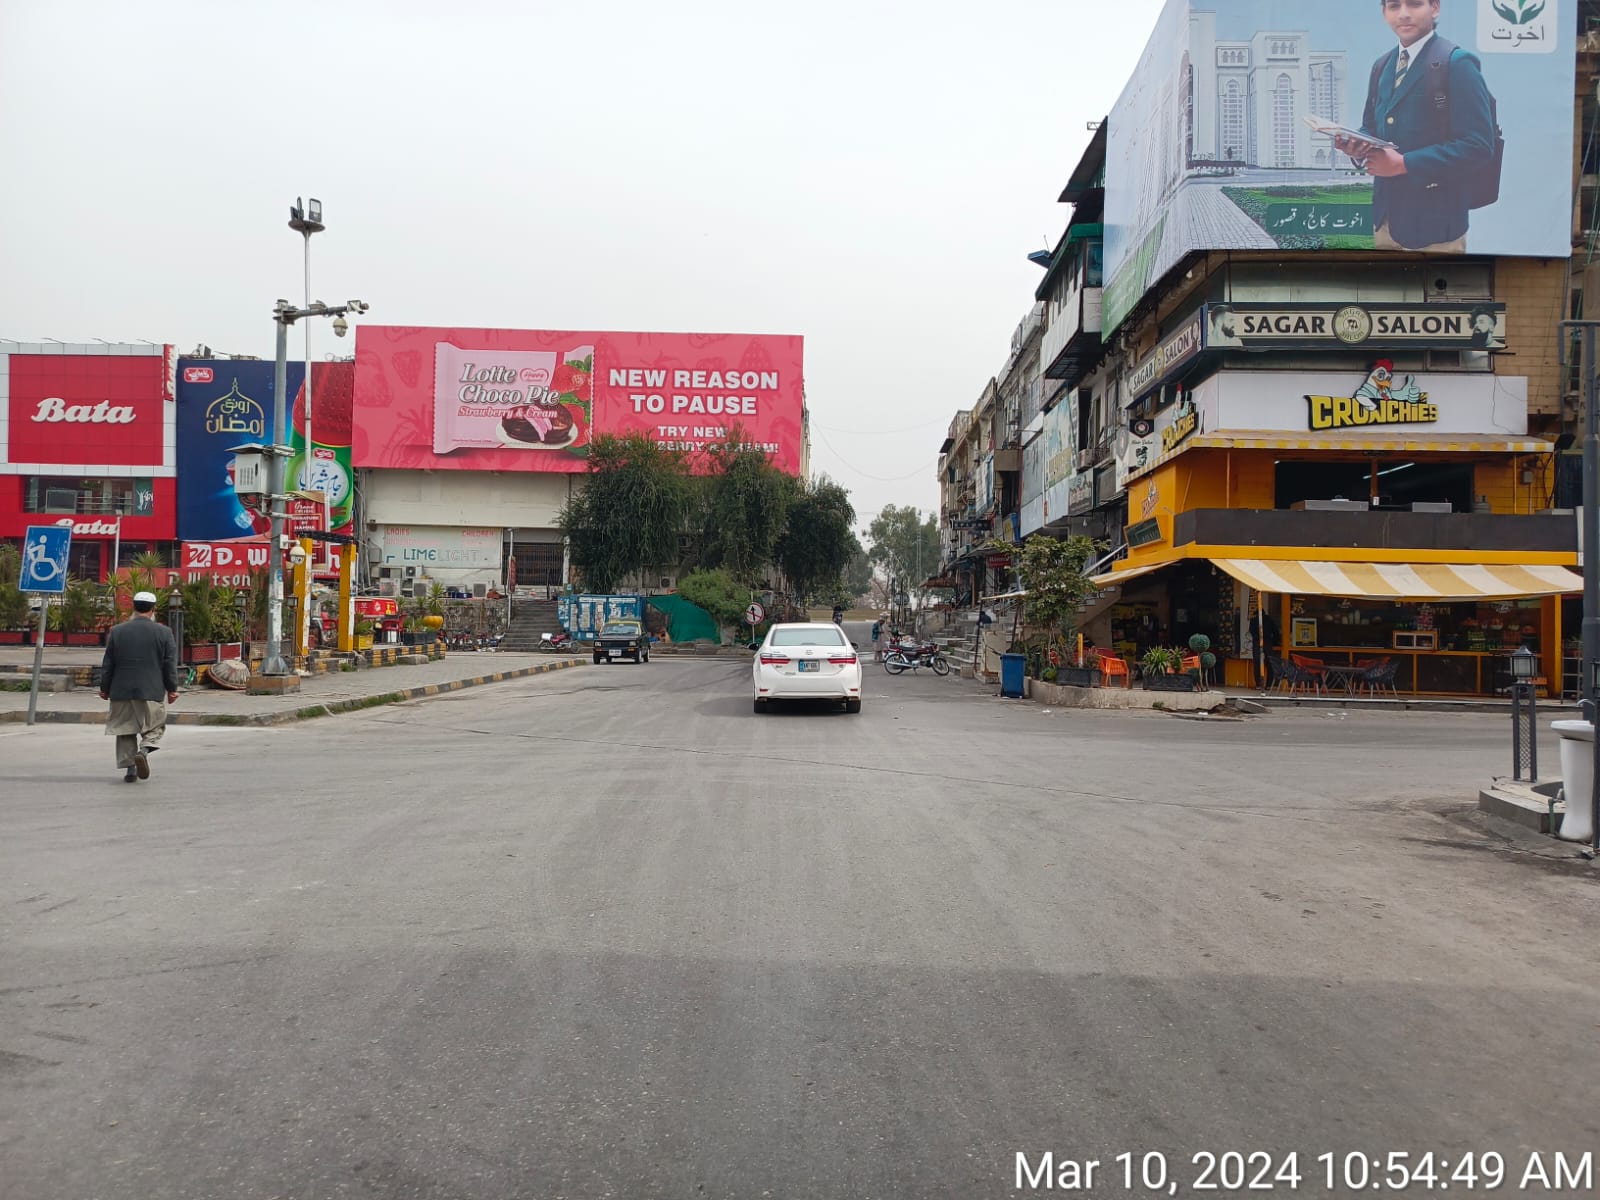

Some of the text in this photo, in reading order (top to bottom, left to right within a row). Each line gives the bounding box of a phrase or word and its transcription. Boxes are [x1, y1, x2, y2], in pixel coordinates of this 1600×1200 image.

[1491, 24, 1544, 47] اخوت
[1273, 208, 1297, 227] قصور
[1333, 212, 1363, 228] اخوت
[1243, 316, 1461, 334] SAGAR SALON
[1133, 332, 1190, 390] SAGAR SALON
[459, 363, 517, 384] Lotte
[610, 369, 778, 389] NEW REASON
[459, 384, 560, 406] Choco Pie
[631, 395, 757, 415] TO PAUSE
[31, 398, 136, 423] Bata
[458, 407, 513, 419] Strawberry
[526, 408, 558, 419] Cream
[206, 414, 264, 438] رمضان
[658, 426, 728, 438] TRY NEW
[188, 571, 251, 587] Wtson
